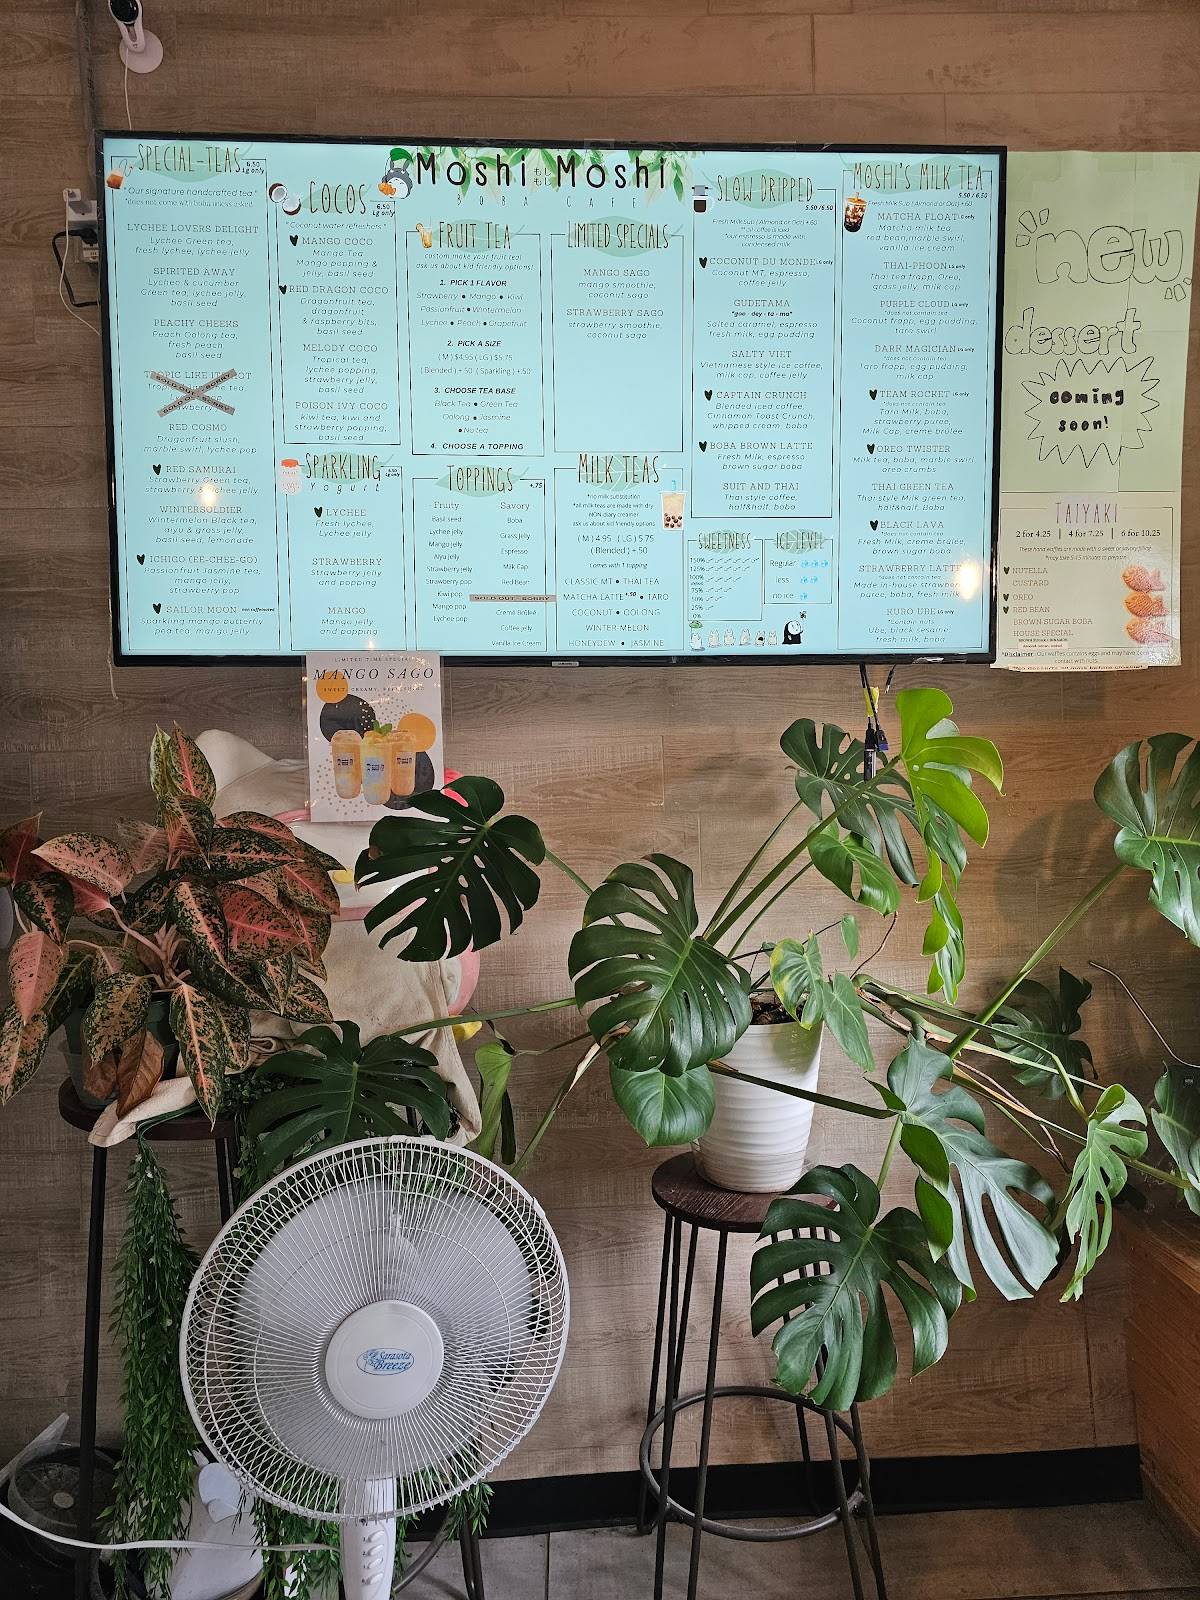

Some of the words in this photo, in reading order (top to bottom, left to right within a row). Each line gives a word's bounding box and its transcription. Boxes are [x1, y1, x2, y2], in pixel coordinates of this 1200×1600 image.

[138, 144, 241, 173] SPECIAL-TEAS
[417, 153, 526, 186] Moshi
[557, 155, 664, 189] Moshi
[854, 163, 911, 190] MOSHI'S
[920, 164, 951, 190] MILK
[959, 166, 983, 190] TEA
[718, 175, 752, 202] SLOW
[761, 175, 813, 202] DRIPPED
[310, 181, 366, 214] COCOS
[566, 197, 636, 208] CAFE
[878, 213, 921, 221] MATCHA
[127, 223, 168, 232] LYCHEE
[171, 224, 211, 233] LOVERS
[215, 225, 259, 234] DELIGHT
[439, 222, 476, 248] FRUIT
[485, 222, 511, 249] TEA
[568, 221, 610, 248] LIMITED
[617, 224, 669, 248] SPECIALS
[302, 237, 341, 245] MANGO
[345, 238, 373, 246] COCO
[1036, 226, 1183, 284] new
[884, 262, 947, 270] THAI-PHOON
[153, 268, 199, 276] SPIRITED
[203, 268, 235, 276] AWAY
[623, 269, 650, 277] SAGO
[289, 285, 309, 293] RED
[313, 286, 356, 294] DRAGON
[360, 286, 389, 294] COCO
[880, 300, 915, 308] PURPLE
[566, 309, 633, 317] STRAWBERRY
[637, 309, 664, 317] SAGO
[154, 319, 195, 327] PEACHY
[199, 320, 239, 328] CHEEKS
[1004, 307, 1141, 355] dessert
[303, 344, 345, 352] MELODY
[905, 345, 956, 353] MAGICIAN
[295, 402, 333, 410] POISON
[337, 402, 354, 410] IVY
[192, 424, 227, 432] COSMO
[1059, 416, 1108, 432] soon!
[188, 466, 237, 474] SAMURAI
[305, 453, 381, 481] SPARKLING
[578, 454, 613, 483] MILK
[623, 456, 659, 483] TEAS
[447, 465, 513, 491] TOPPINGS
[310, 483, 380, 494] Yogurt
[872, 483, 896, 491] THAI
[899, 483, 931, 491] GREEN
[934, 483, 954, 491] TEA
[160, 506, 242, 514] WINTERSOLDIER
[434, 501, 459, 510] Fruity
[500, 502, 530, 511] Savory
[326, 509, 367, 517] LYCHEE
[1056, 502, 1118, 524] TAIYAKI
[699, 533, 751, 549] SWEETNESS
[149, 555, 186, 563] ICHIGO
[312, 558, 382, 566] STRAWBERRY
[166, 605, 204, 614] SAILOR
[207, 606, 237, 614] MOON
[328, 607, 366, 615] MANGO
[887, 608, 914, 616] KURO
[313, 668, 379, 680] MANGO
[387, 668, 434, 679] SAGO
[380, 1352, 411, 1360] Sarasota
[375, 1360, 410, 1370] Breeze
